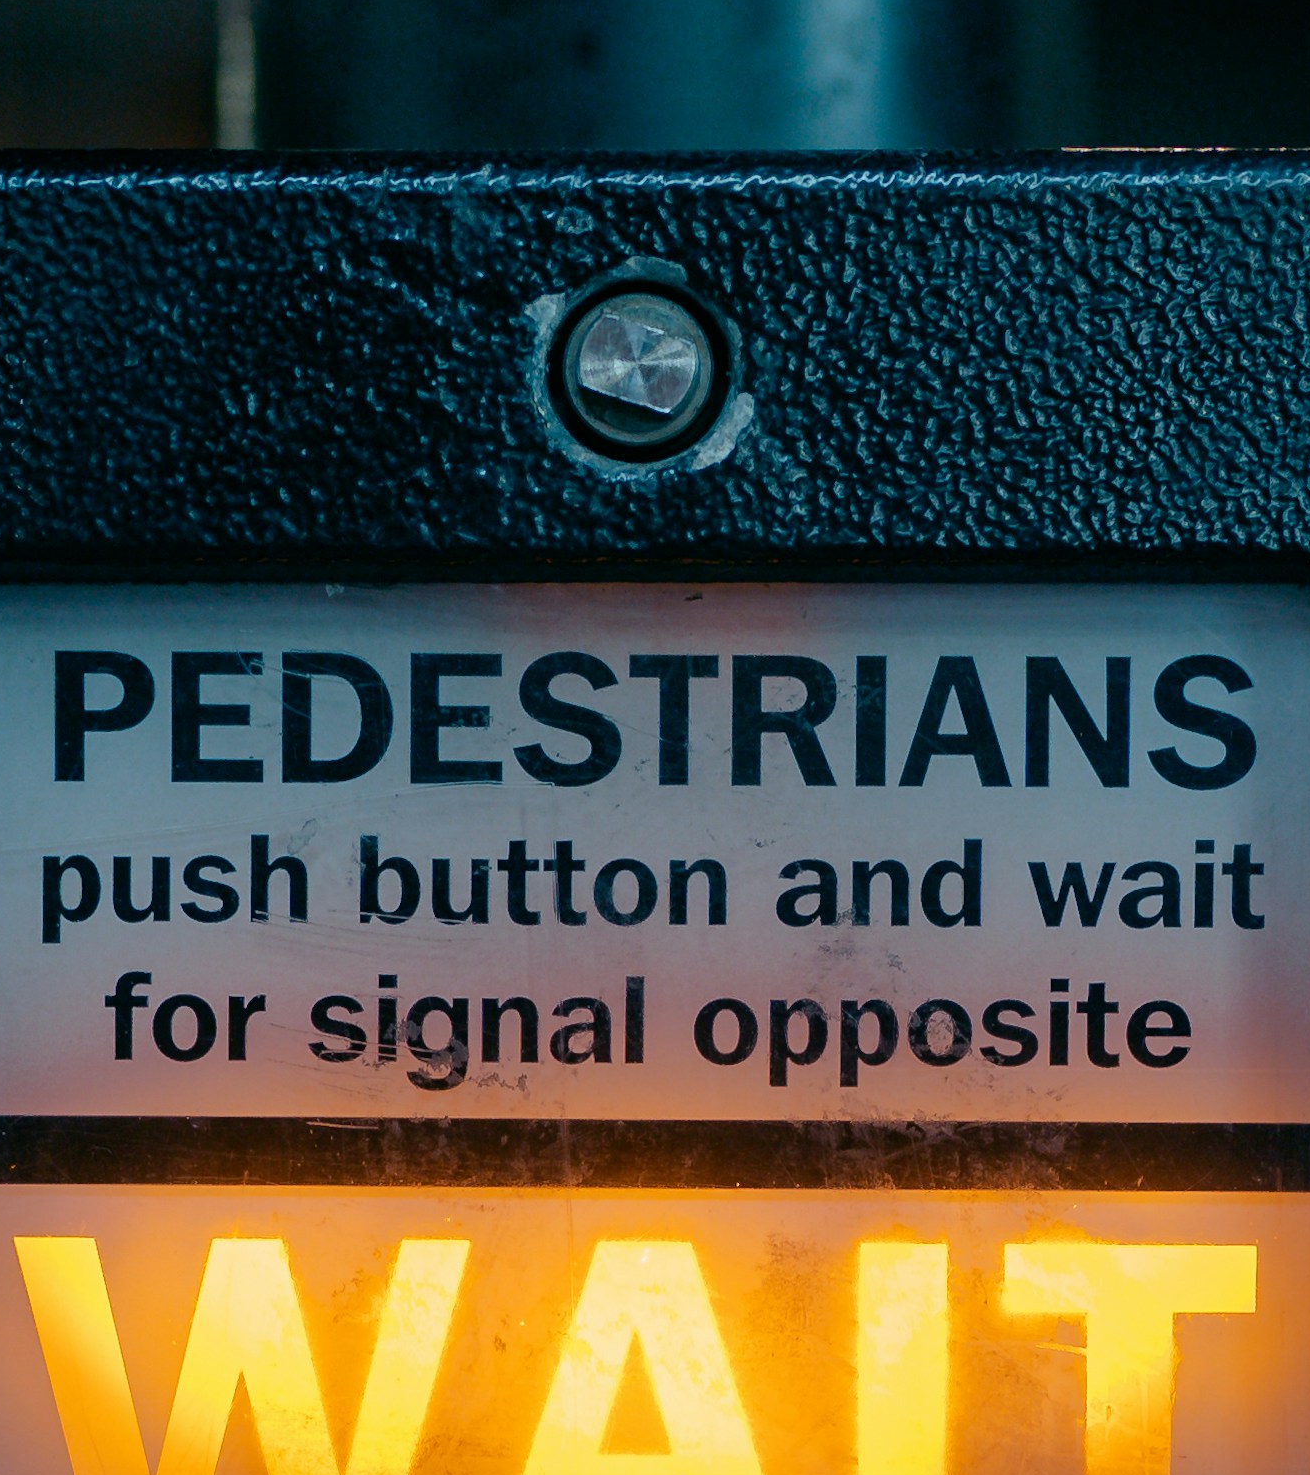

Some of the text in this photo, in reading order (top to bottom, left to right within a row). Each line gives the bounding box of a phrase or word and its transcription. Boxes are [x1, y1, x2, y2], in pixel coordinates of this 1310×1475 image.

[51, 649, 1258, 790] PEDESTRIANS
[42, 834, 1266, 943] push button and wait
[105, 971, 1192, 1091] for signal opposite
